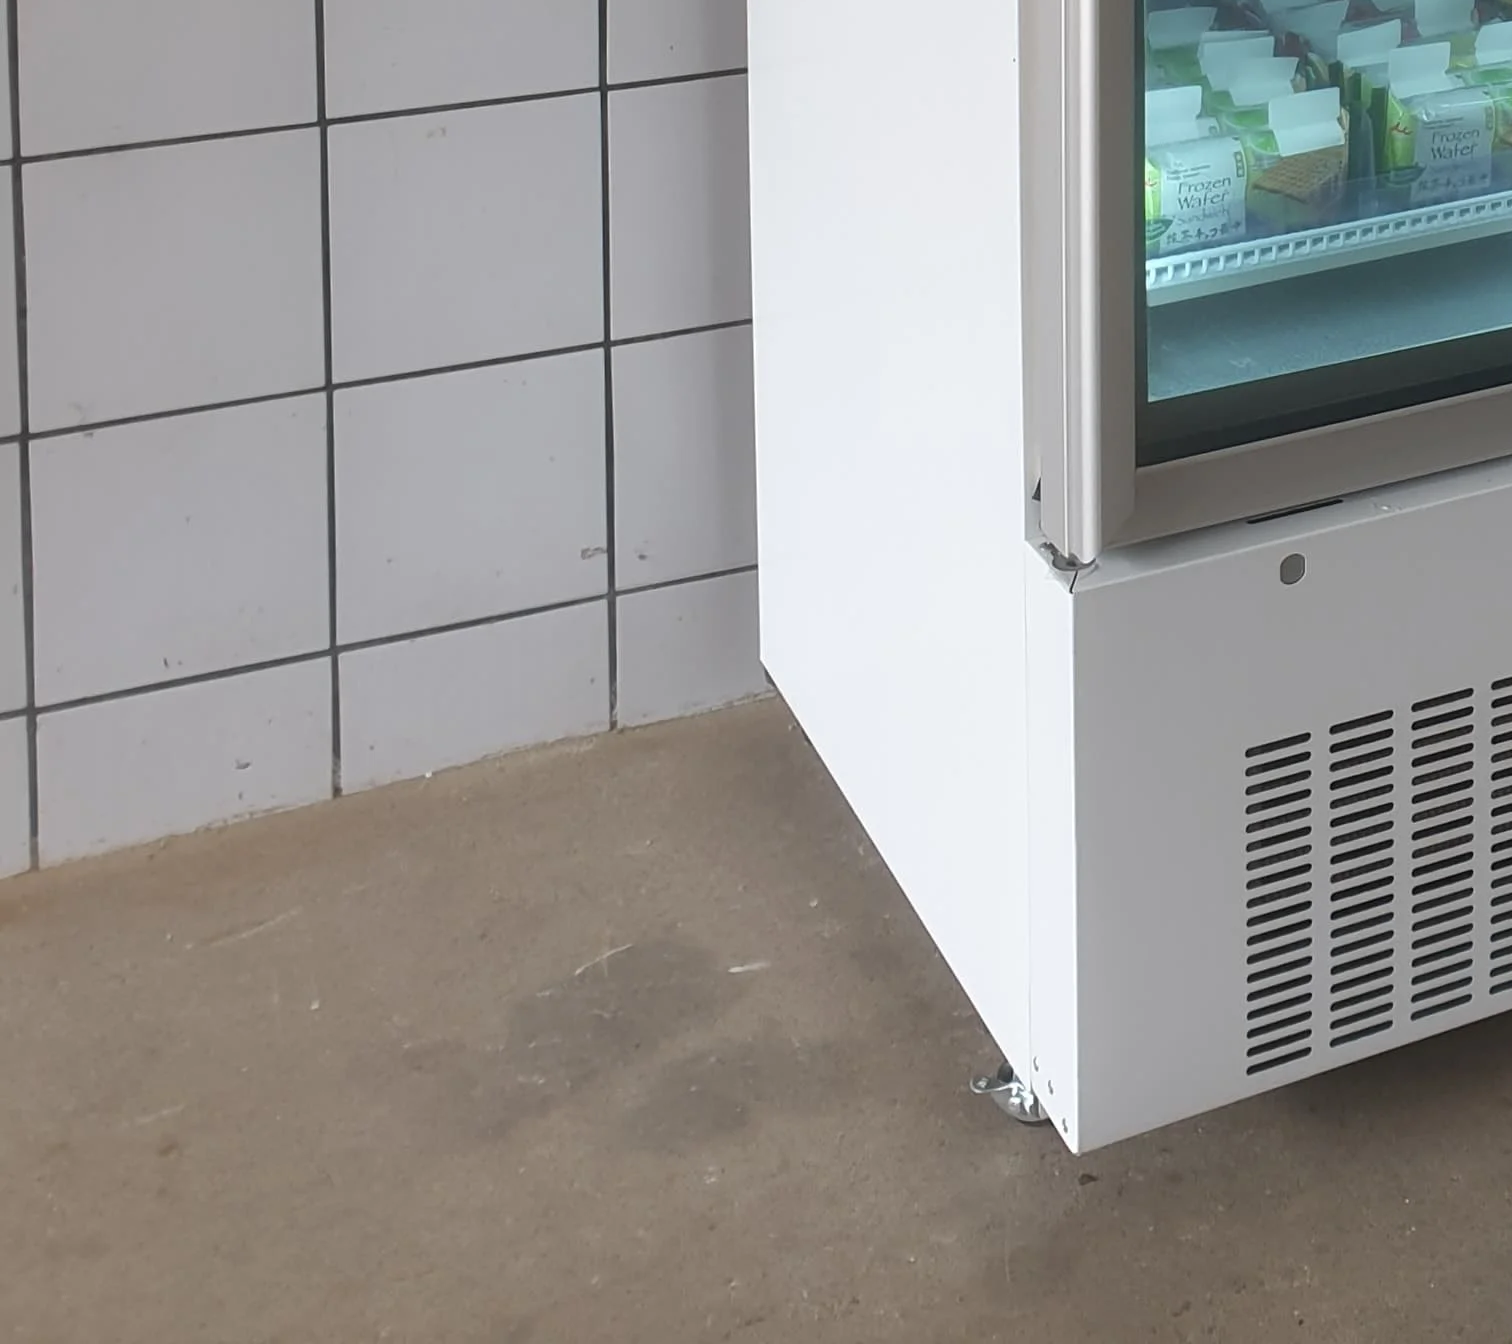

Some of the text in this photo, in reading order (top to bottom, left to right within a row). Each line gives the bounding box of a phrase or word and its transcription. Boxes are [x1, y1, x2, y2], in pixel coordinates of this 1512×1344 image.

[1432, 129, 1480, 144] Frozen
[1431, 143, 1479, 160] Wafer
[1178, 177, 1231, 194] Frozen
[1177, 191, 1230, 210] Wafer
